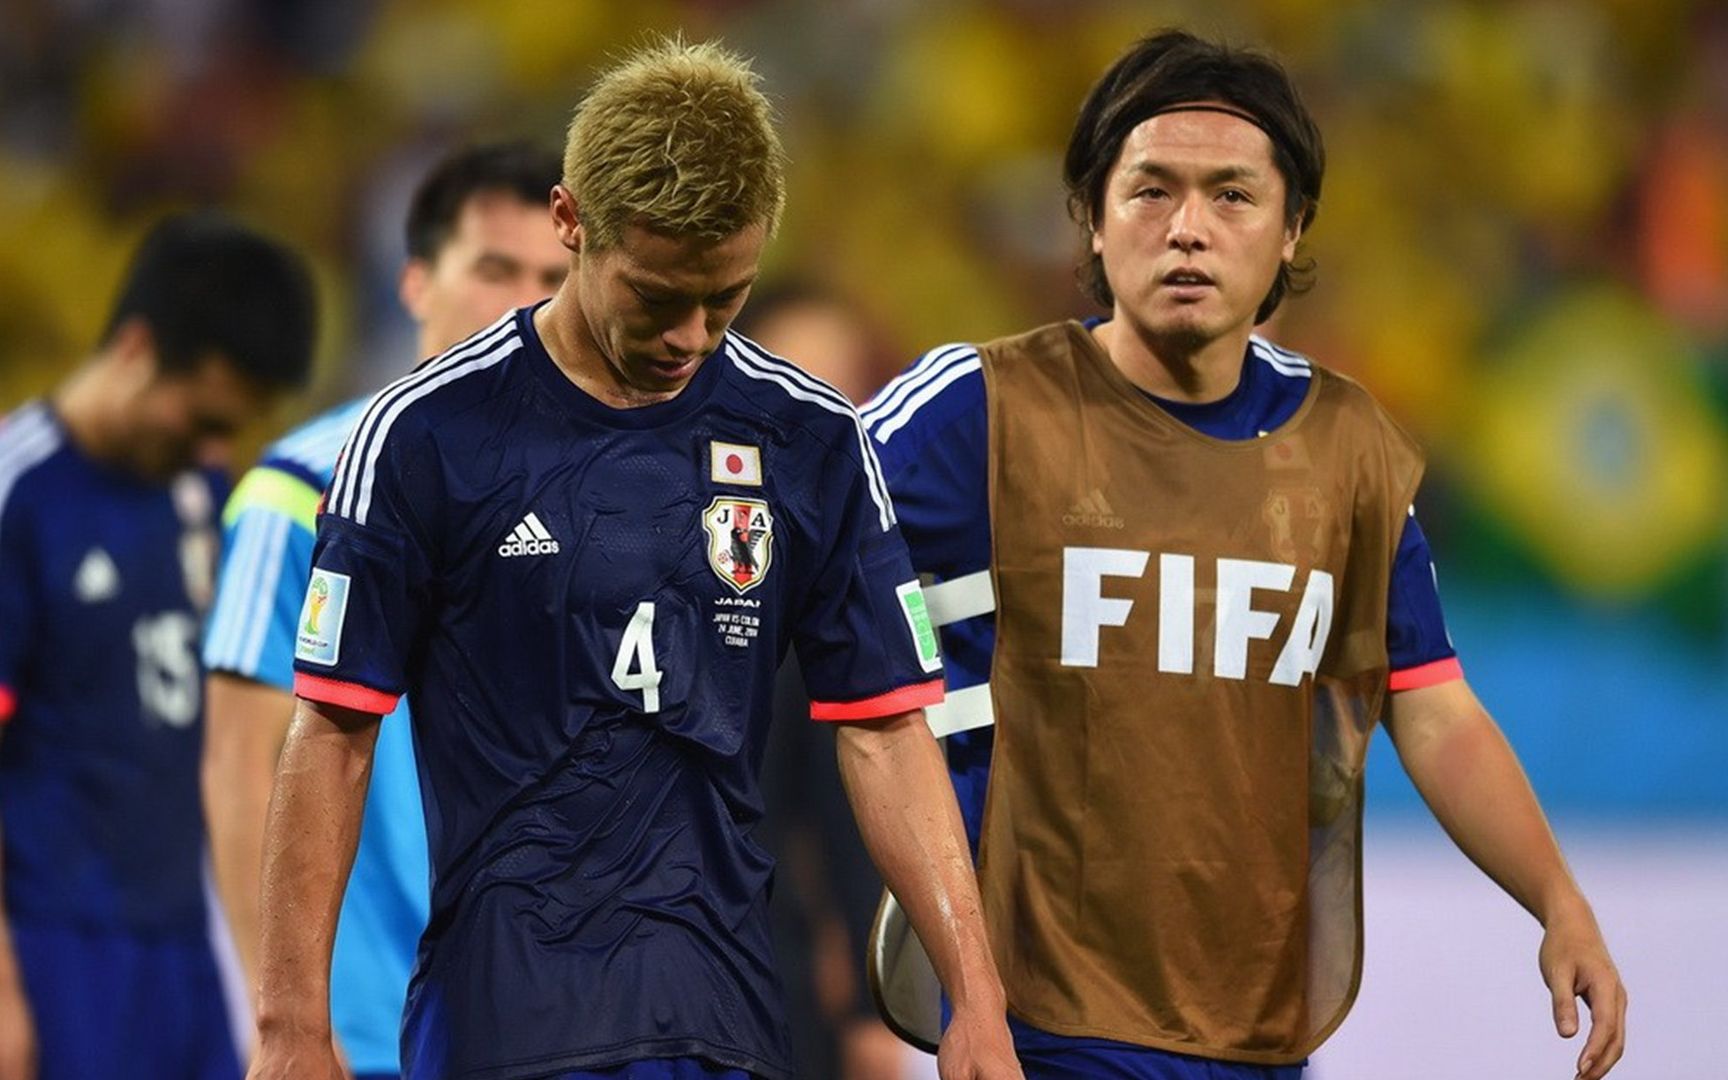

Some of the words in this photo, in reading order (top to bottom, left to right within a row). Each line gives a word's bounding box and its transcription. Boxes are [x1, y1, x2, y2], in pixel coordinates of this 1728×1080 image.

[498, 540, 560, 557] adidas
[132, 611, 199, 729] 15
[611, 602, 663, 713] 4
[1060, 546, 1334, 687] FIFA
